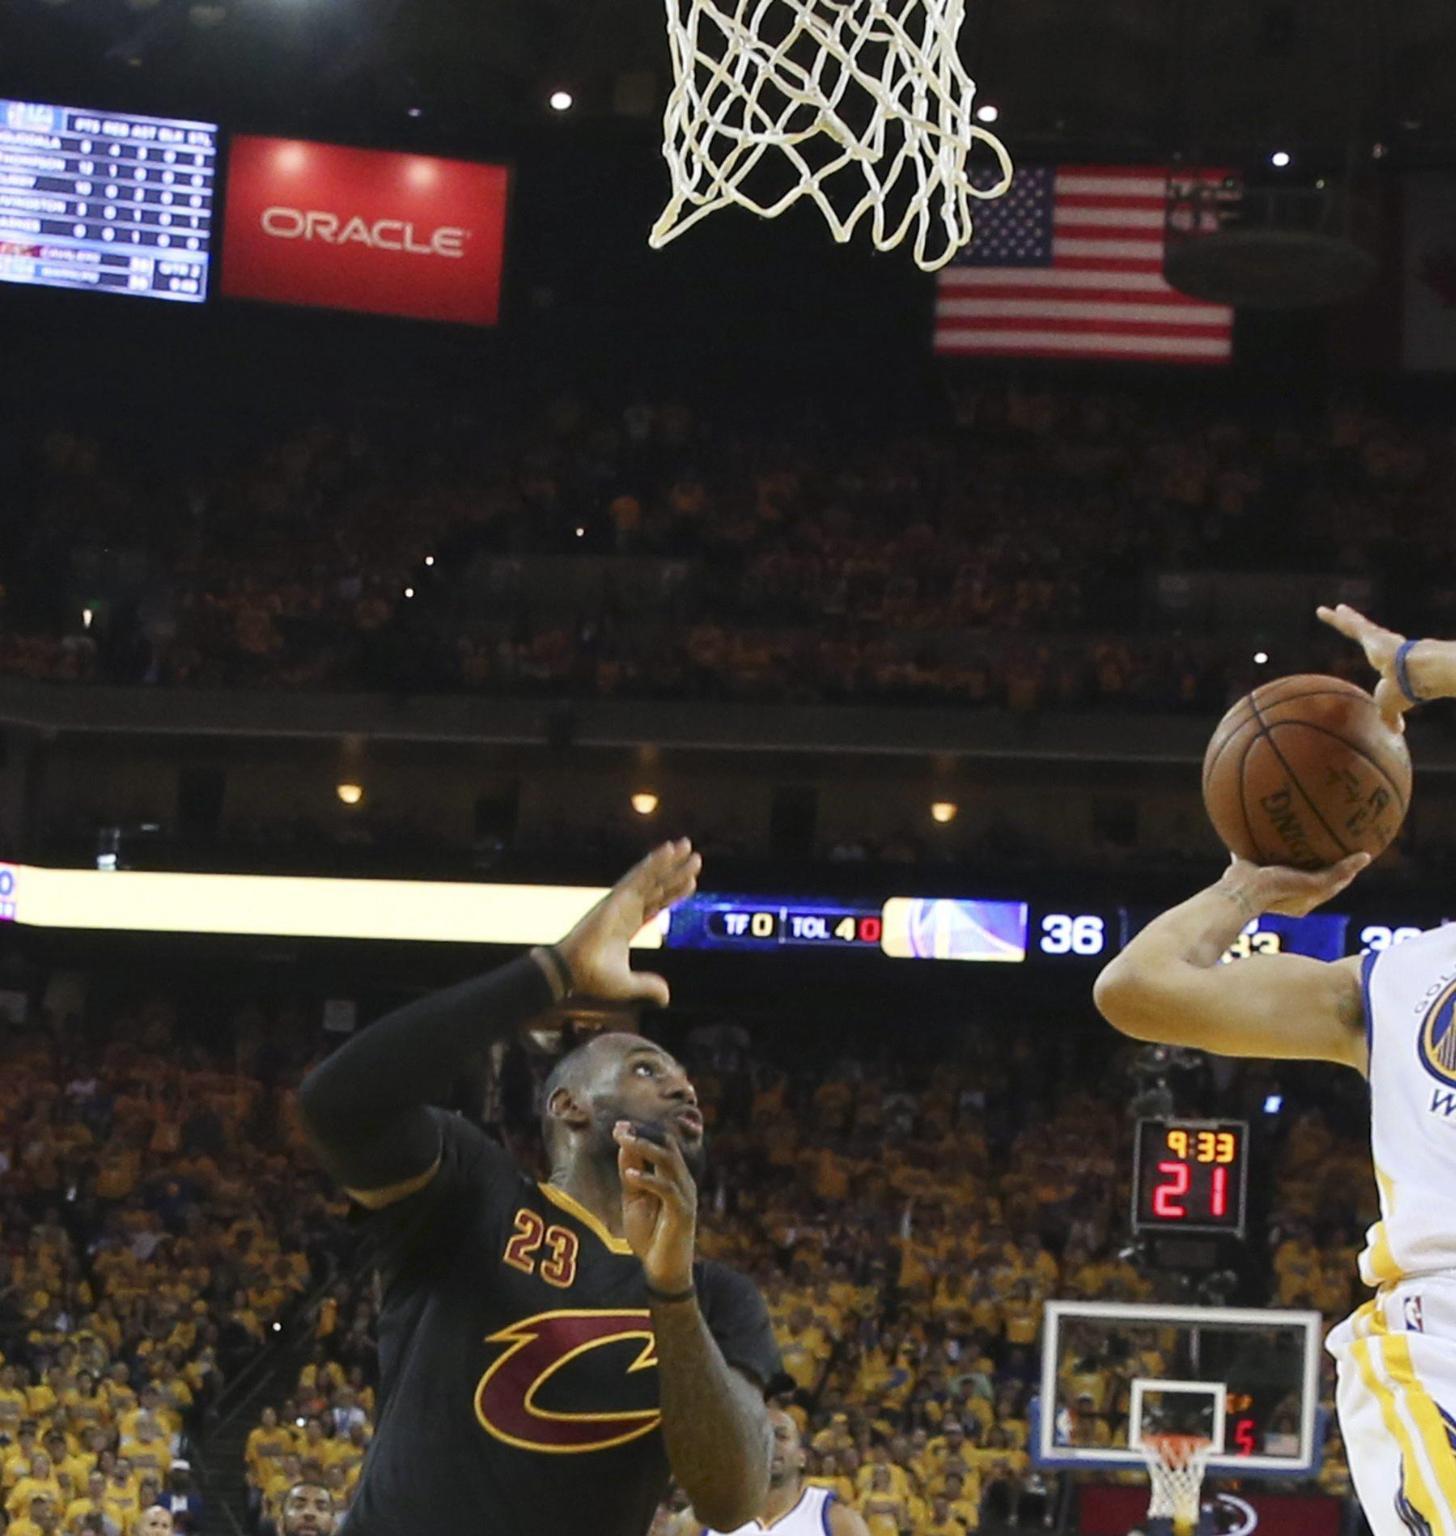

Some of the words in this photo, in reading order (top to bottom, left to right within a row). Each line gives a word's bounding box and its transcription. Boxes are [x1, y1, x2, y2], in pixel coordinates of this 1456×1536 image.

[260, 206, 465, 258] ORACLE
[1040, 914, 1104, 955] 36
[1166, 1130, 1236, 1164] 9:33
[1154, 1162, 1227, 1218] 21
[503, 1208, 579, 1288] 23
